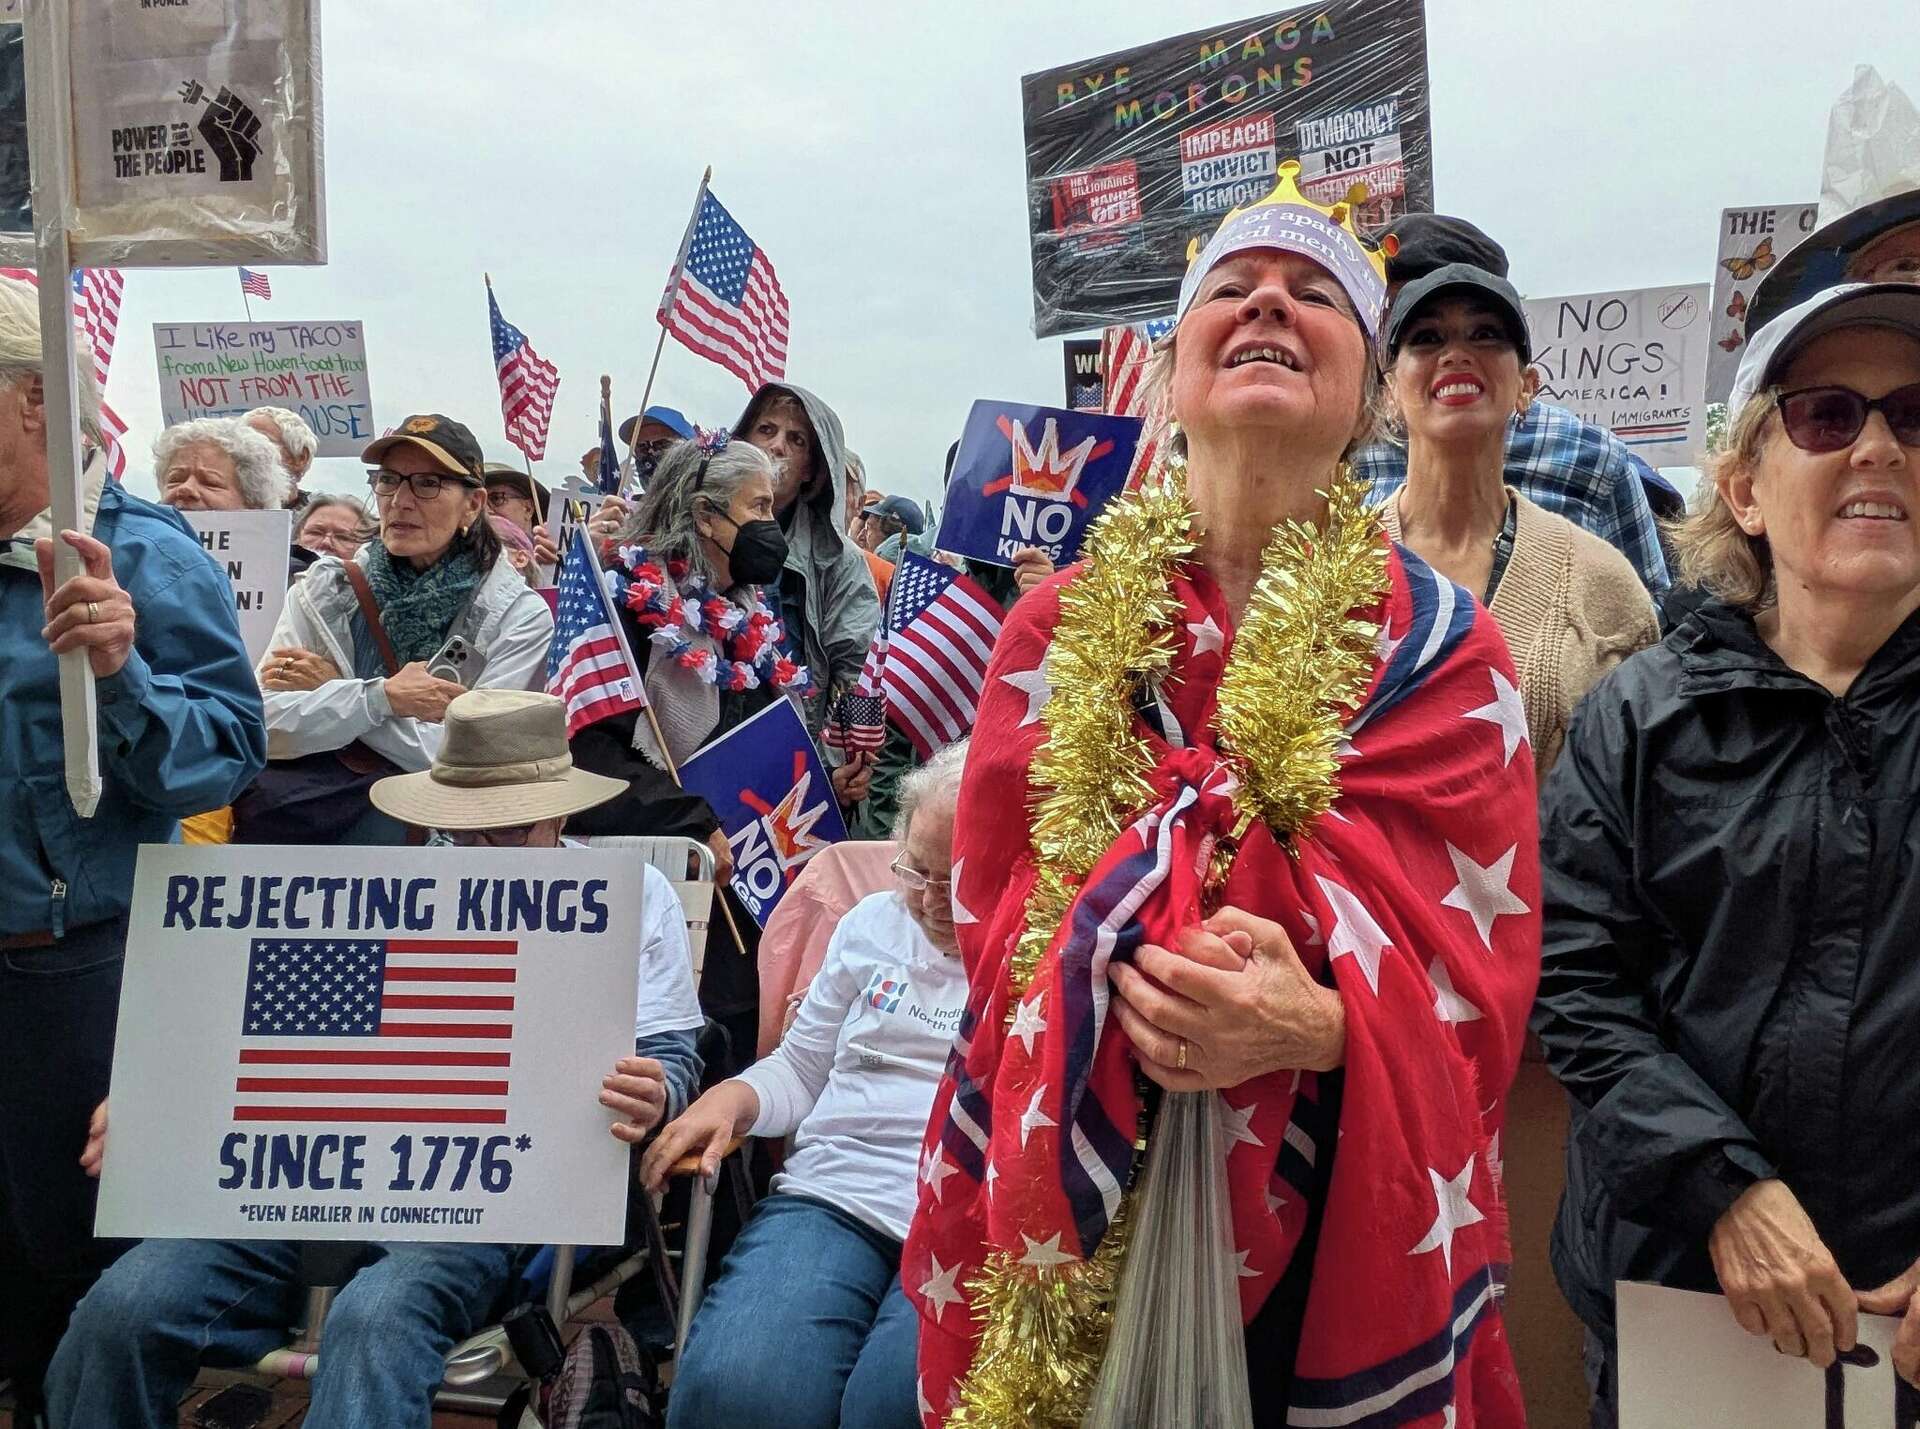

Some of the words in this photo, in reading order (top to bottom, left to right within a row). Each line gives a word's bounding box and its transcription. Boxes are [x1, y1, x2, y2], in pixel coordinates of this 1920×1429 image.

[1200, 15, 1335, 72] MAGA
[1114, 57, 1312, 130] MORONS
[112, 125, 168, 152] POWER
[1186, 120, 1269, 157] IMPEACH
[1300, 103, 1395, 150] DEMOCRACY
[114, 153, 141, 178] THE
[145, 150, 206, 176] PEOPLE
[1188, 151, 1270, 184] CONVICT
[1324, 143, 1376, 174] NOT
[1070, 175, 1089, 187] HEY
[1090, 187, 1137, 207] HANDS
[1193, 179, 1271, 213] REMOVE
[1243, 208, 1276, 225] of
[1280, 210, 1359, 261] apathy
[1727, 210, 1776, 235] THE
[1558, 299, 1628, 338] NO
[159, 328, 186, 348] I
[250, 330, 276, 353] my
[217, 352, 249, 376] New
[253, 351, 299, 374] Haven
[299, 352, 334, 373] food
[1531, 342, 1664, 381] KINGS
[179, 377, 231, 408] NOT
[305, 374, 354, 400] THE
[297, 404, 370, 439] OUSE
[1611, 407, 1691, 425] IMMIGRANTS
[1001, 496, 1072, 543] NO
[199, 531, 231, 550] HE
[997, 537, 1064, 561] KIS
[728, 819, 780, 899] NO
[162, 875, 437, 931] REJECTING
[458, 878, 609, 933] KINGS
[908, 1004, 947, 1031] North
[218, 1132, 367, 1191] SINCE
[292, 1205, 352, 1224] EARLIER
[358, 1206, 375, 1224] IN
[380, 1207, 484, 1225] CONNECTICUT
